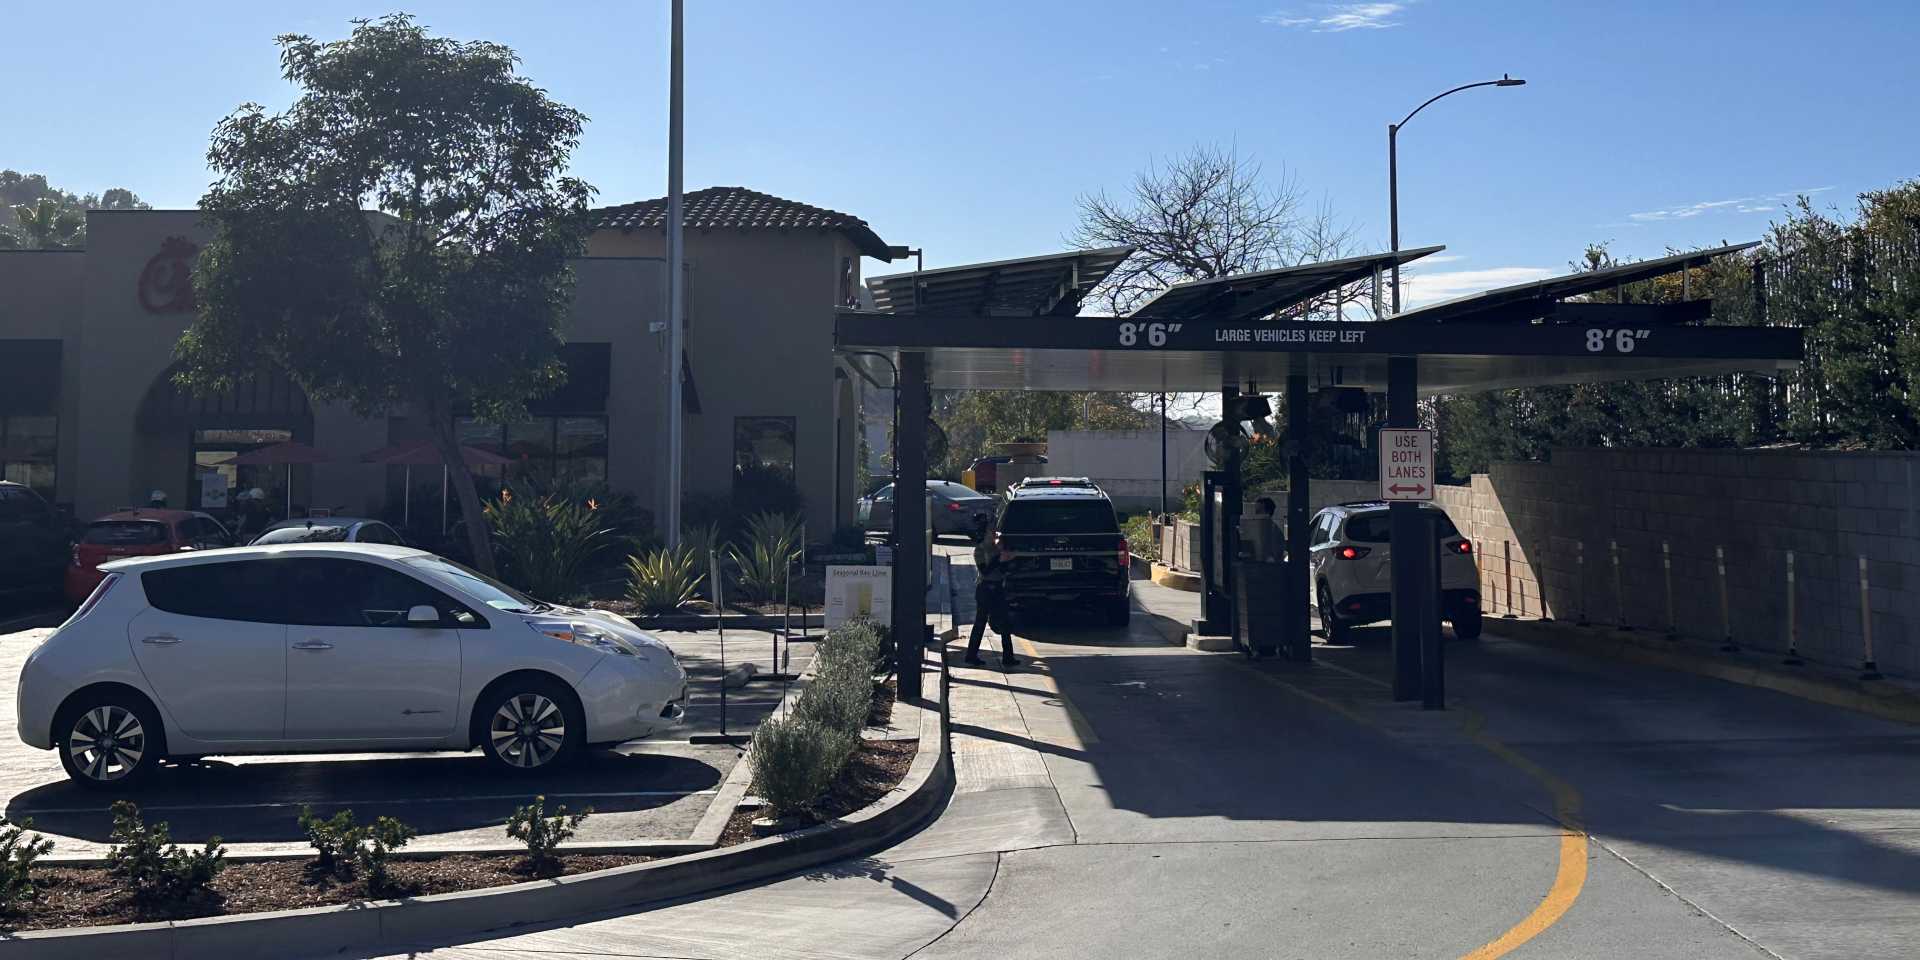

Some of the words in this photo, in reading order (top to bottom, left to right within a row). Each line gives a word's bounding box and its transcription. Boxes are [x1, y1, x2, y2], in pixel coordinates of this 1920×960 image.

[1215, 329, 1251, 342] LARGE
[1254, 329, 1306, 342] VEHICLES
[1309, 329, 1337, 343] KEEP
[1340, 330, 1366, 344] LEFT
[1395, 435, 1418, 448] USE
[1391, 450, 1422, 463] BOTH
[1388, 466, 1426, 479] LANES
